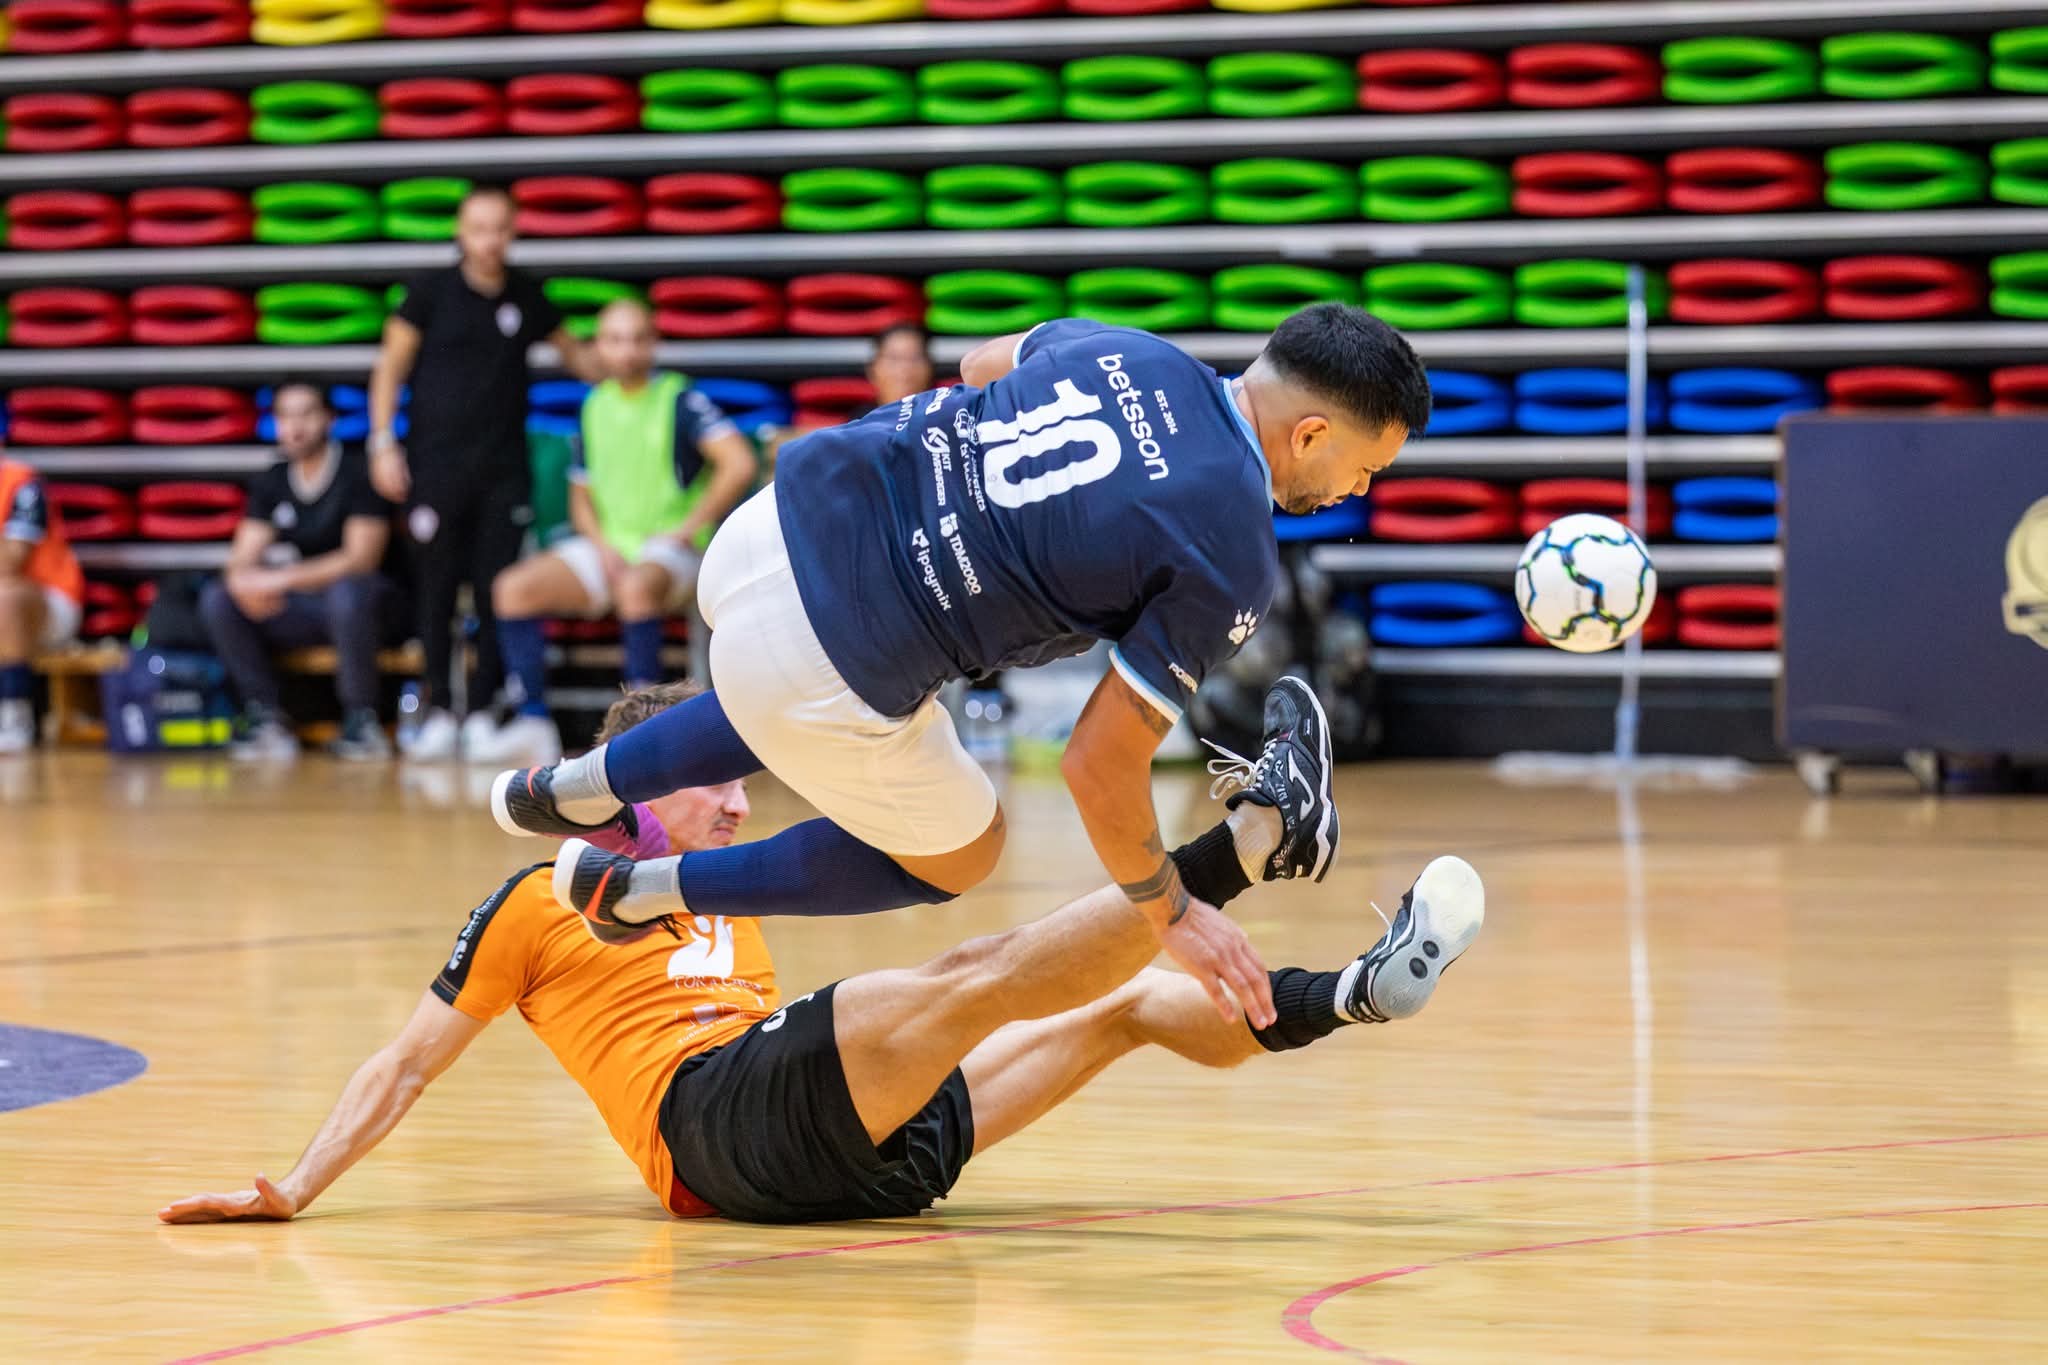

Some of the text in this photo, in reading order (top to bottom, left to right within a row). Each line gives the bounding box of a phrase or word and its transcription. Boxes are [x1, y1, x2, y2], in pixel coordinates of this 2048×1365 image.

[1096, 353, 1170, 481] betsson
[1154, 389, 1169, 412] EST.
[941, 452, 952, 472] KIT
[976, 378, 1122, 509] 10
[931, 452, 946, 506] MANAGER
[916, 548, 952, 611] ipaymix
[949, 533, 982, 594] TDM2000
